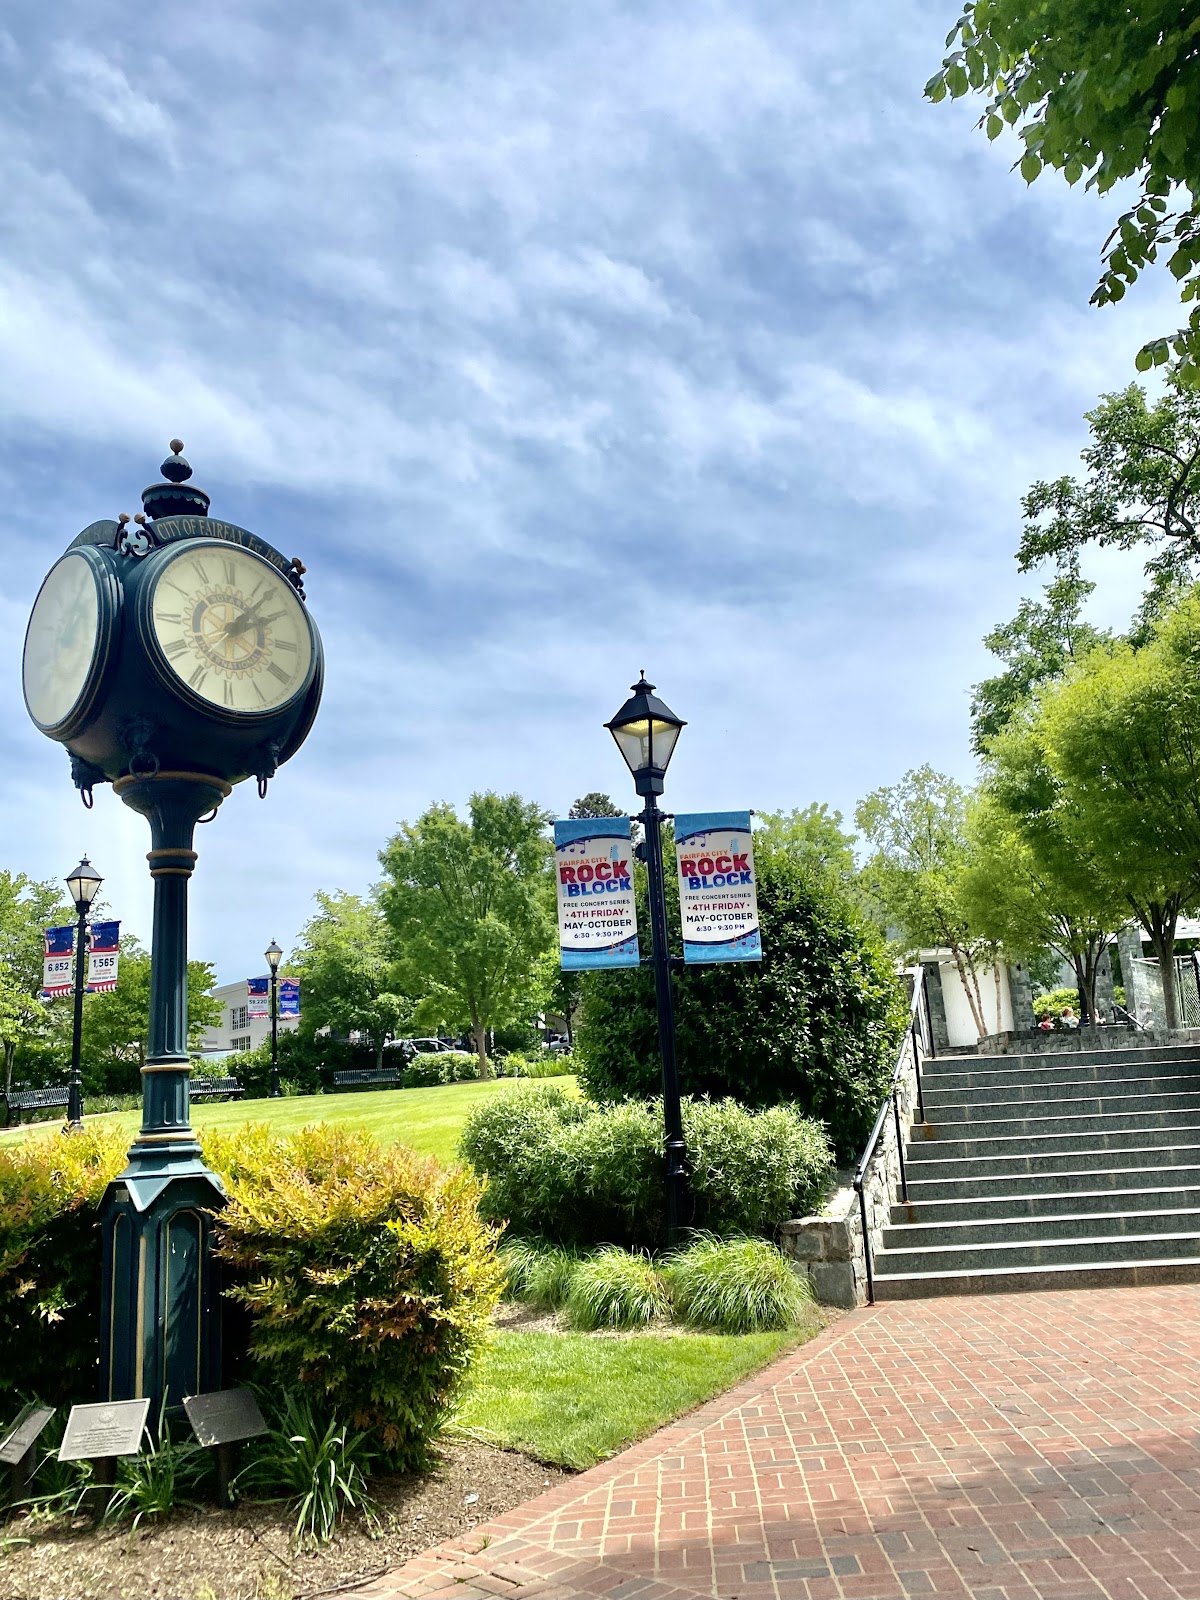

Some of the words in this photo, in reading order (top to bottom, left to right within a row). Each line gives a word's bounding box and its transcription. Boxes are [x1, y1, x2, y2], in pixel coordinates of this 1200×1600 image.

[157, 521, 181, 540] CITY
[183, 519, 196, 535] OF
[200, 519, 244, 545] FAIRFAX
[679, 852, 711, 860] FAIRFAX
[559, 859, 590, 867] FAIRFAX
[680, 853, 751, 878] ROCK
[559, 860, 631, 885] ROCK
[688, 871, 753, 890] BLOCK
[567, 877, 633, 898] BLOCK
[692, 903, 711, 911] 4TH
[712, 902, 745, 910] FRIDAY
[570, 910, 589, 918] 4TH
[591, 908, 625, 917] FRIDAY
[686, 912, 753, 923] MAY-OCTOBER
[564, 919, 632, 930] MAY-OCTOBER
[47, 962, 69, 972] 6,852
[93, 957, 115, 969] 1,565
